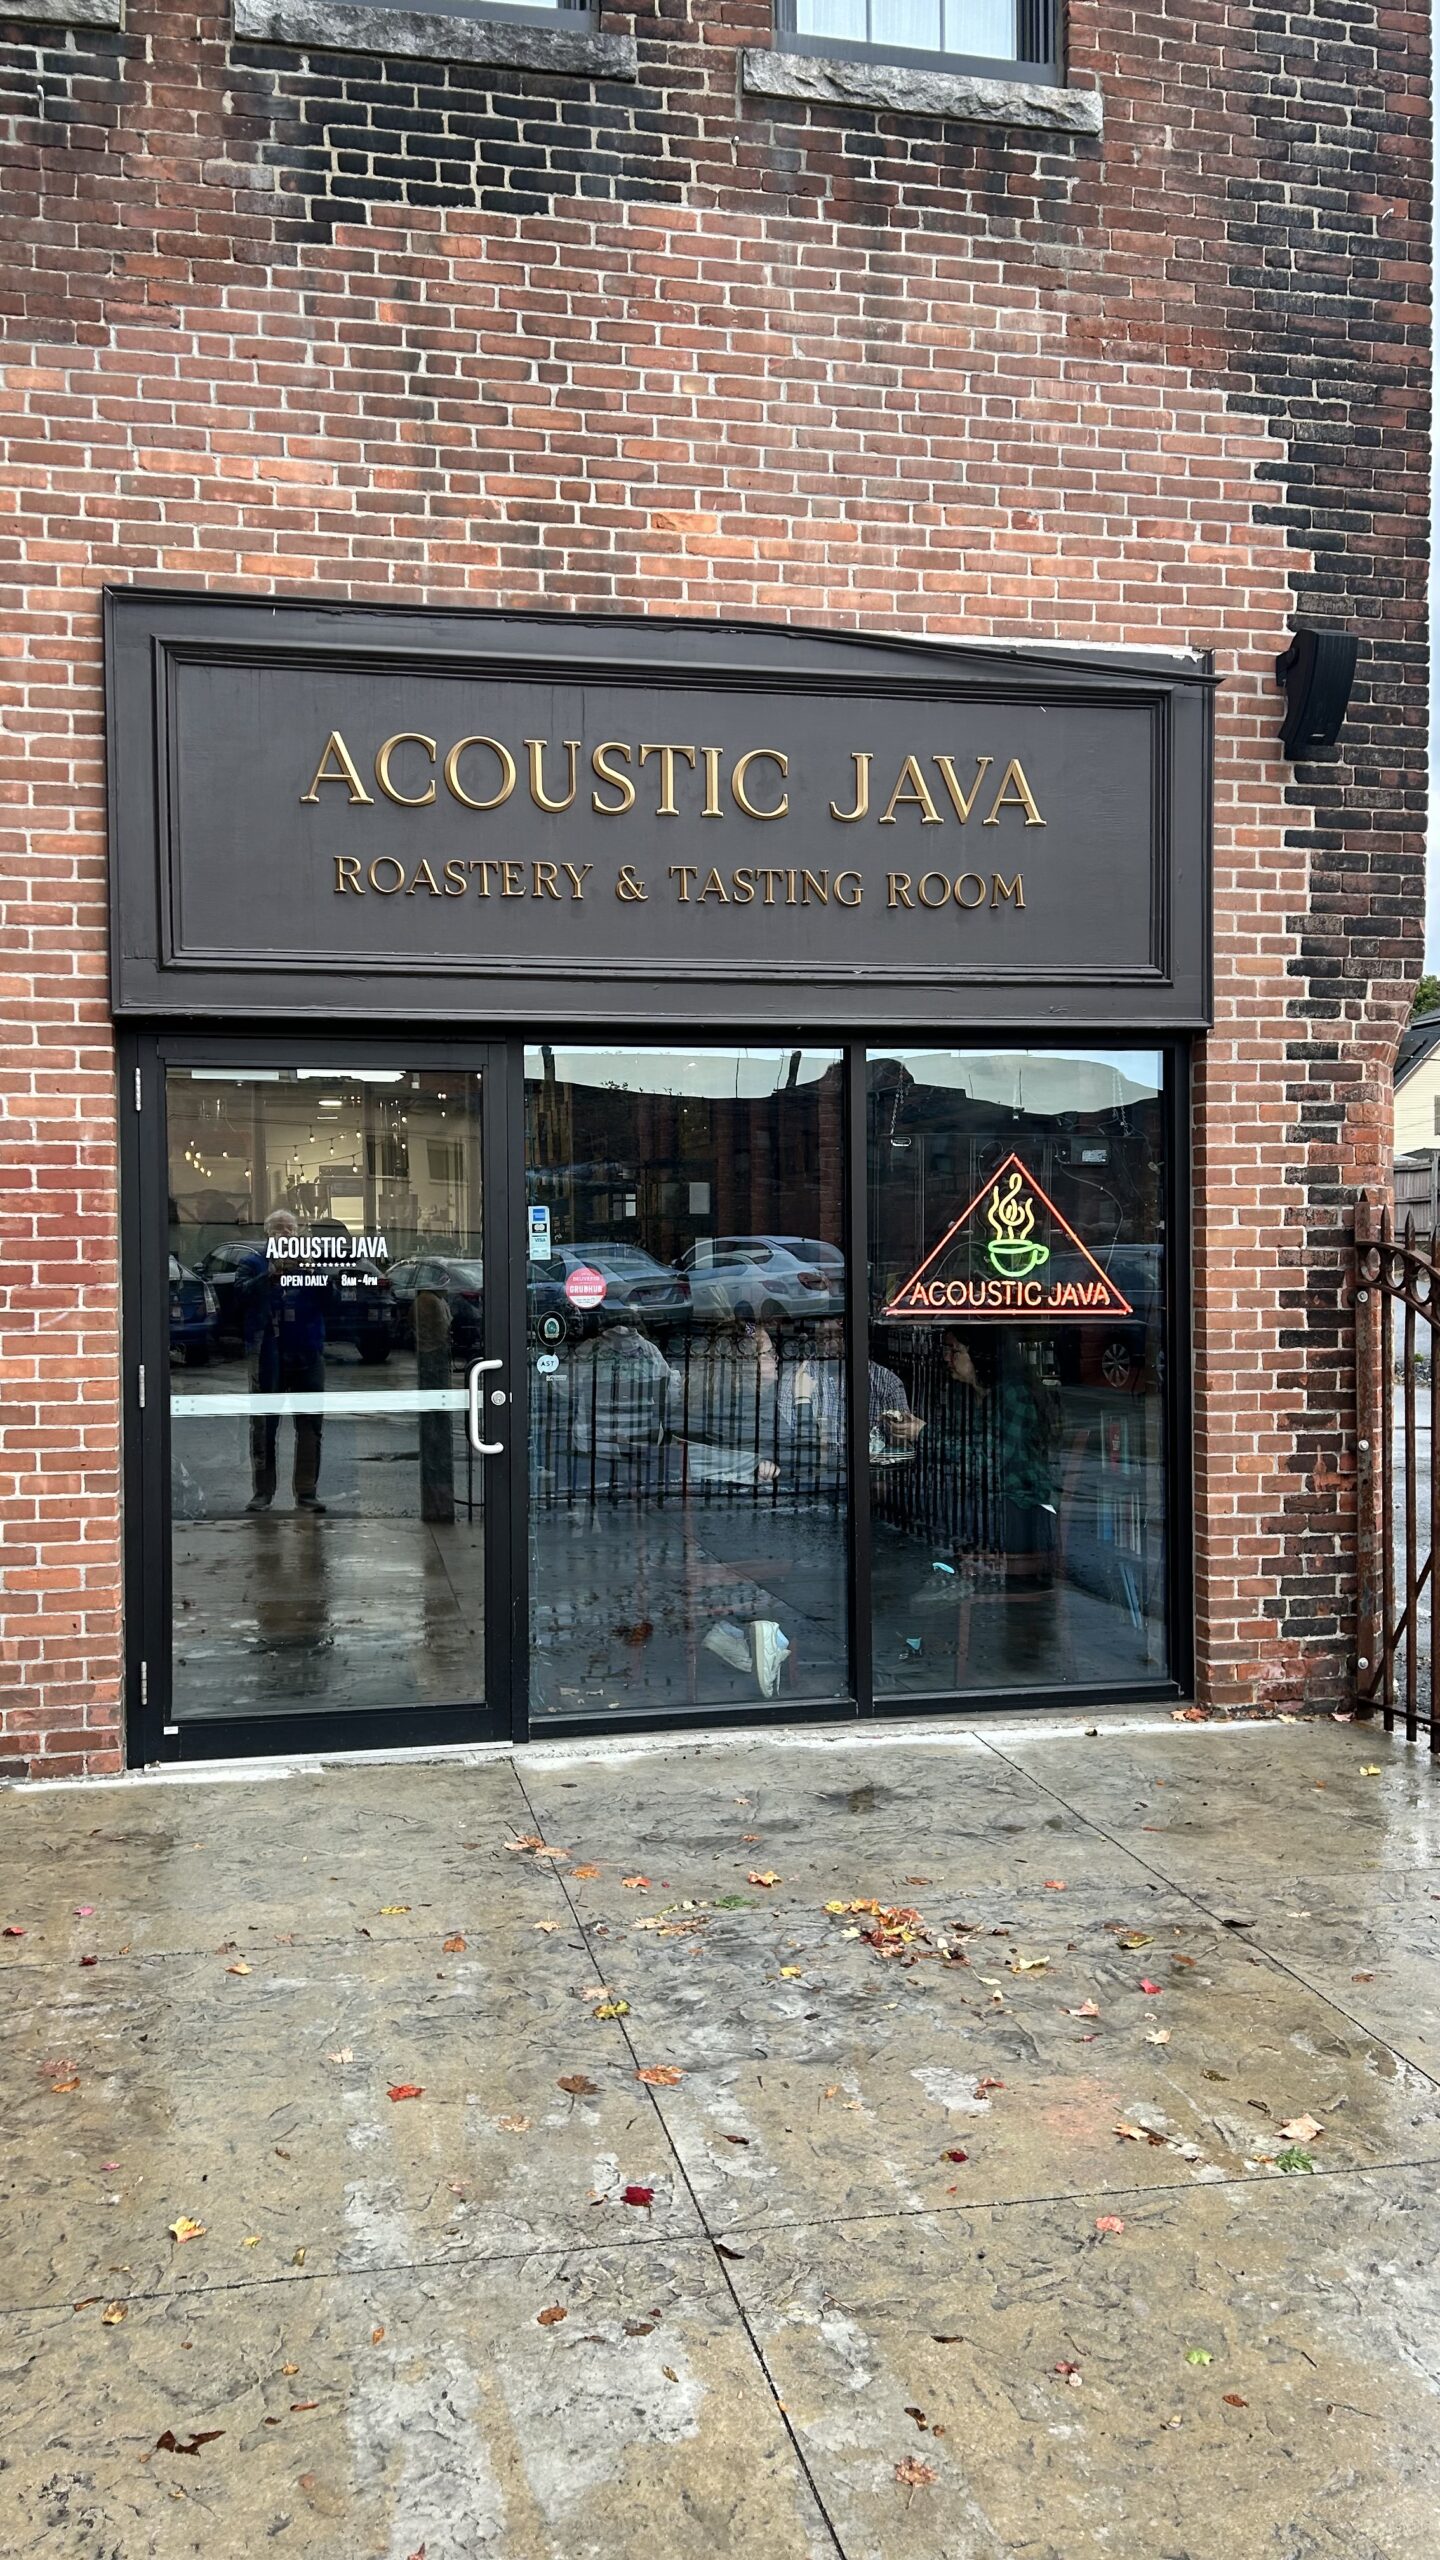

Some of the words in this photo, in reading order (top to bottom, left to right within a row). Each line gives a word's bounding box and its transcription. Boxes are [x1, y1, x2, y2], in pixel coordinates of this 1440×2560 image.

[301, 730, 790, 820] ACOUSTIC
[829, 752, 1047, 827] JAVA
[333, 855, 593, 901] ROASTERY
[615, 864, 648, 903] &
[669, 865, 864, 907] TASTING
[887, 871, 1026, 909] ROOM
[266, 1236, 347, 1259] ACOUSTIC
[350, 1236, 388, 1259] JAVA
[280, 1275, 303, 1287] OPEN
[304, 1275, 329, 1287] DAILY
[569, 1285, 603, 1294] GRUBHUB
[909, 1280, 1042, 1307] ACOUSTIC
[1047, 1281, 1111, 1306] JAVA
